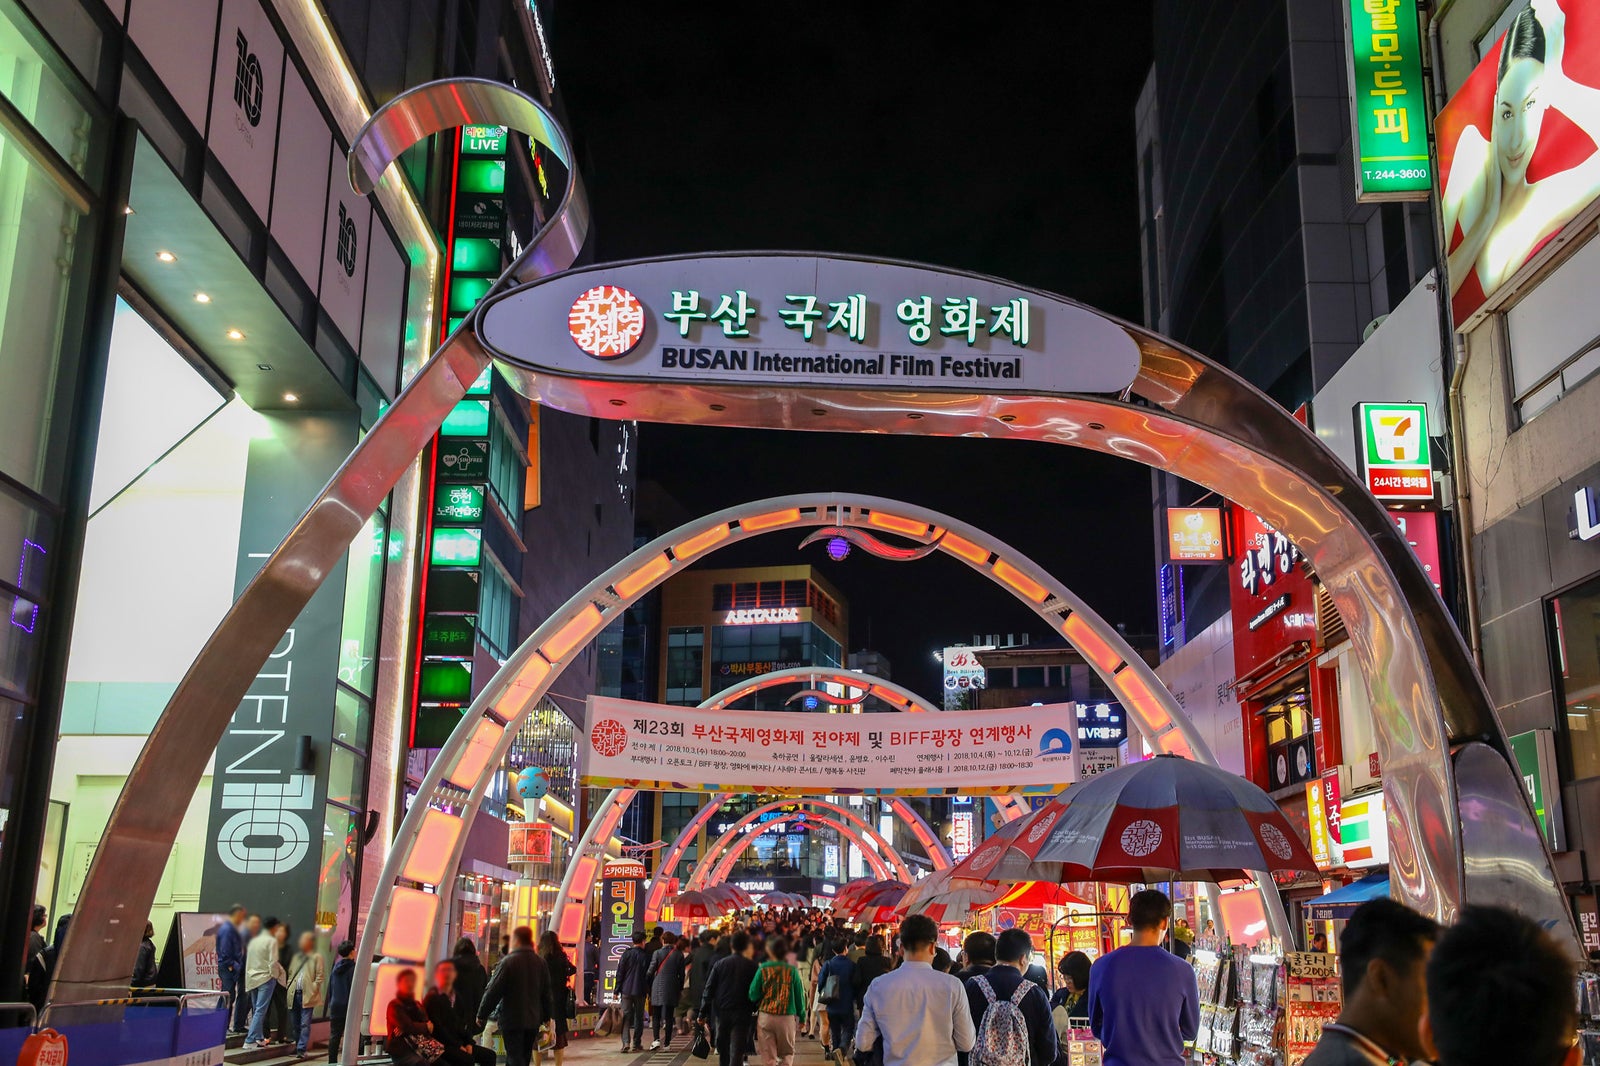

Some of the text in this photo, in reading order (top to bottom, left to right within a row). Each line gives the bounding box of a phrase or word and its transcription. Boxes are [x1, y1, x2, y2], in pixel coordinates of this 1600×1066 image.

[234, 27, 263, 127] 10
[466, 127, 504, 138] 레인보우
[470, 139, 499, 151] LIVE
[1364, 169, 1427, 180] T.244-3600
[337, 200, 357, 277] 10
[664, 290, 1029, 346] 부산 국제 영화제
[662, 348, 1021, 378] BUSAN International Film Festival
[1374, 476, 1427, 488] 24시간 편의점
[437, 505, 481, 518] 노래연습장
[633, 719, 1032, 749] 제23회 부산국제영화제 전야제 및 BIFF광장 연계행사
[666, 757, 692, 767] 오픈토크
[698, 759, 711, 767] BIFF
[771, 752, 799, 761] 축하공연
[916, 753, 943, 762] 연계행사
[999, 761, 1034, 770] 18:00~18:30
[1325, 781, 1341, 834] 본죽
[217, 774, 316, 874] 10
[604, 866, 644, 876] 스카이라운지
